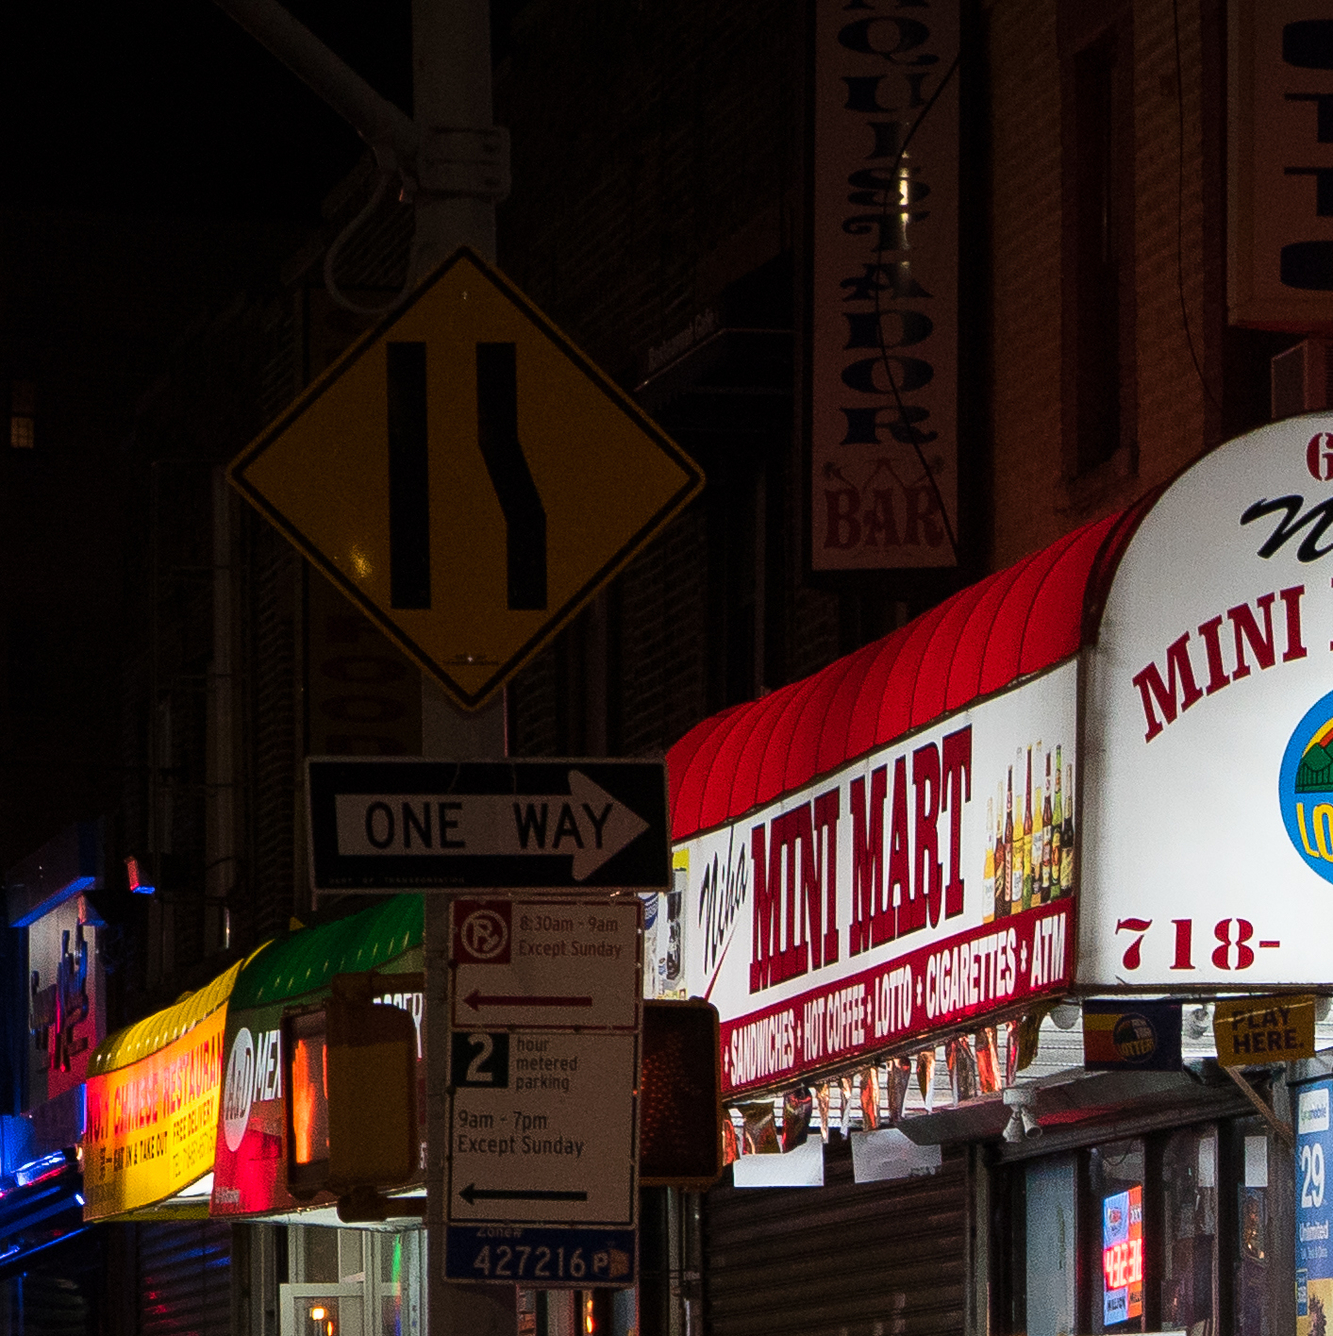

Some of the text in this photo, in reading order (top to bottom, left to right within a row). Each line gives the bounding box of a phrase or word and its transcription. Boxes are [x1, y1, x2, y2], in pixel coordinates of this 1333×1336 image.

[836, 0, 939, 446] QUISTADOR
[823, 485, 945, 551] BAR
[1132, 584, 1308, 744] MINI
[364, 801, 615, 850] ONE WAY
[698, 723, 973, 995] Niha MINI MART
[518, 914, 619, 933] 8:30am 9am
[517, 939, 623, 960] Except Sunday
[730, 911, 1067, 1087] SANDWICHES HOT COFFEE LOTTO CIGARETTES ATM
[1231, 1006, 1291, 1032] PLAY
[464, 1032, 549, 1083] 2 hour
[1232, 1027, 1305, 1055] HERE.
[516, 1055, 579, 1072] metered
[515, 1075, 570, 1092] parking
[114, 1071, 159, 1138] CHINESE
[458, 1109, 548, 1131] 9am 7pm
[139, 1135, 155, 1164] TAKE
[156, 1130, 168, 1156] OUT
[457, 1133, 515, 1157] Except
[521, 1134, 584, 1159] Sunday
[472, 1244, 588, 1279] 427216
